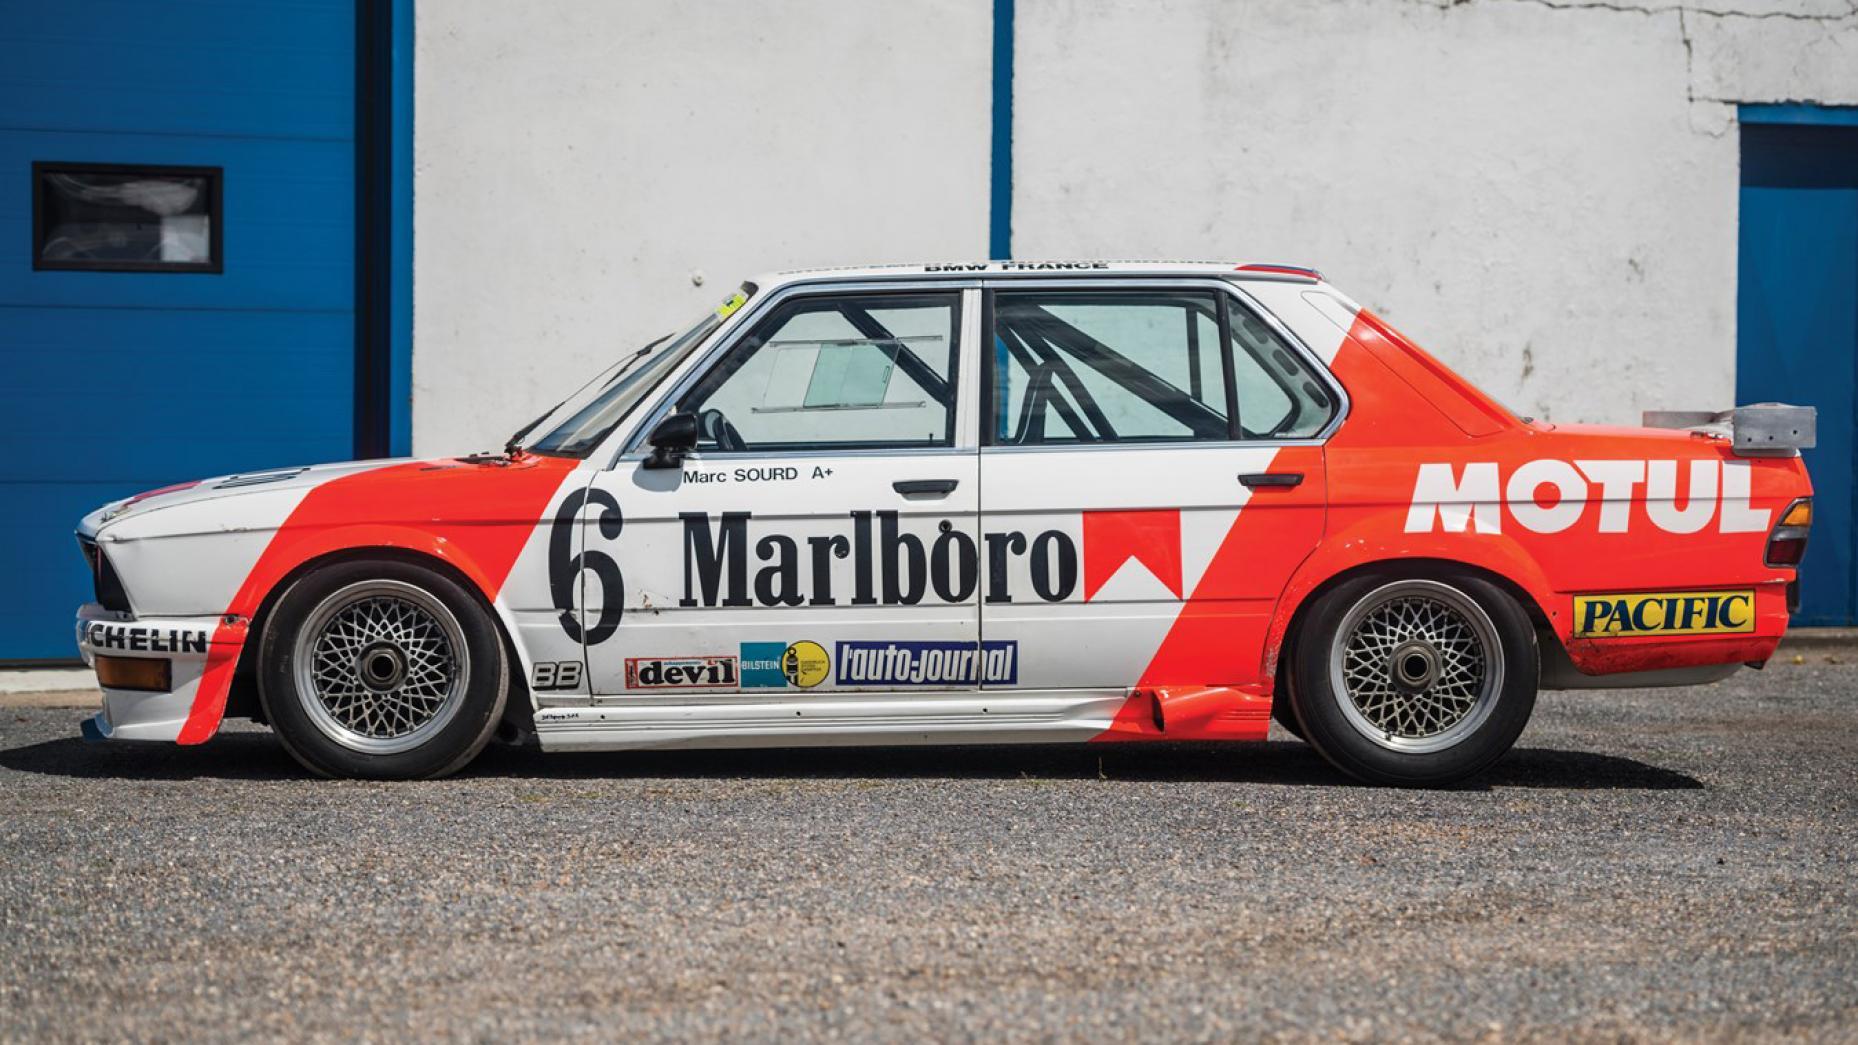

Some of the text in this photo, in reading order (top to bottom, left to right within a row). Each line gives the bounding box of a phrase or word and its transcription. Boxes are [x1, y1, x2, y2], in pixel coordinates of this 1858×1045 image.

[924, 264, 988, 272] BMW
[1001, 262, 1110, 271] FRANCE
[683, 466, 833, 483] Marc SOURD A+
[1404, 459, 1773, 534] MOTUL
[548, 486, 625, 646] 6
[678, 510, 1079, 607] Marlboro
[1582, 595, 1750, 633] PACIFIC
[86, 623, 206, 653] CHELIN
[639, 659, 735, 684] devil
[742, 660, 779, 670] BILSTEIN
[839, 644, 1014, 684] l'auto-journal
